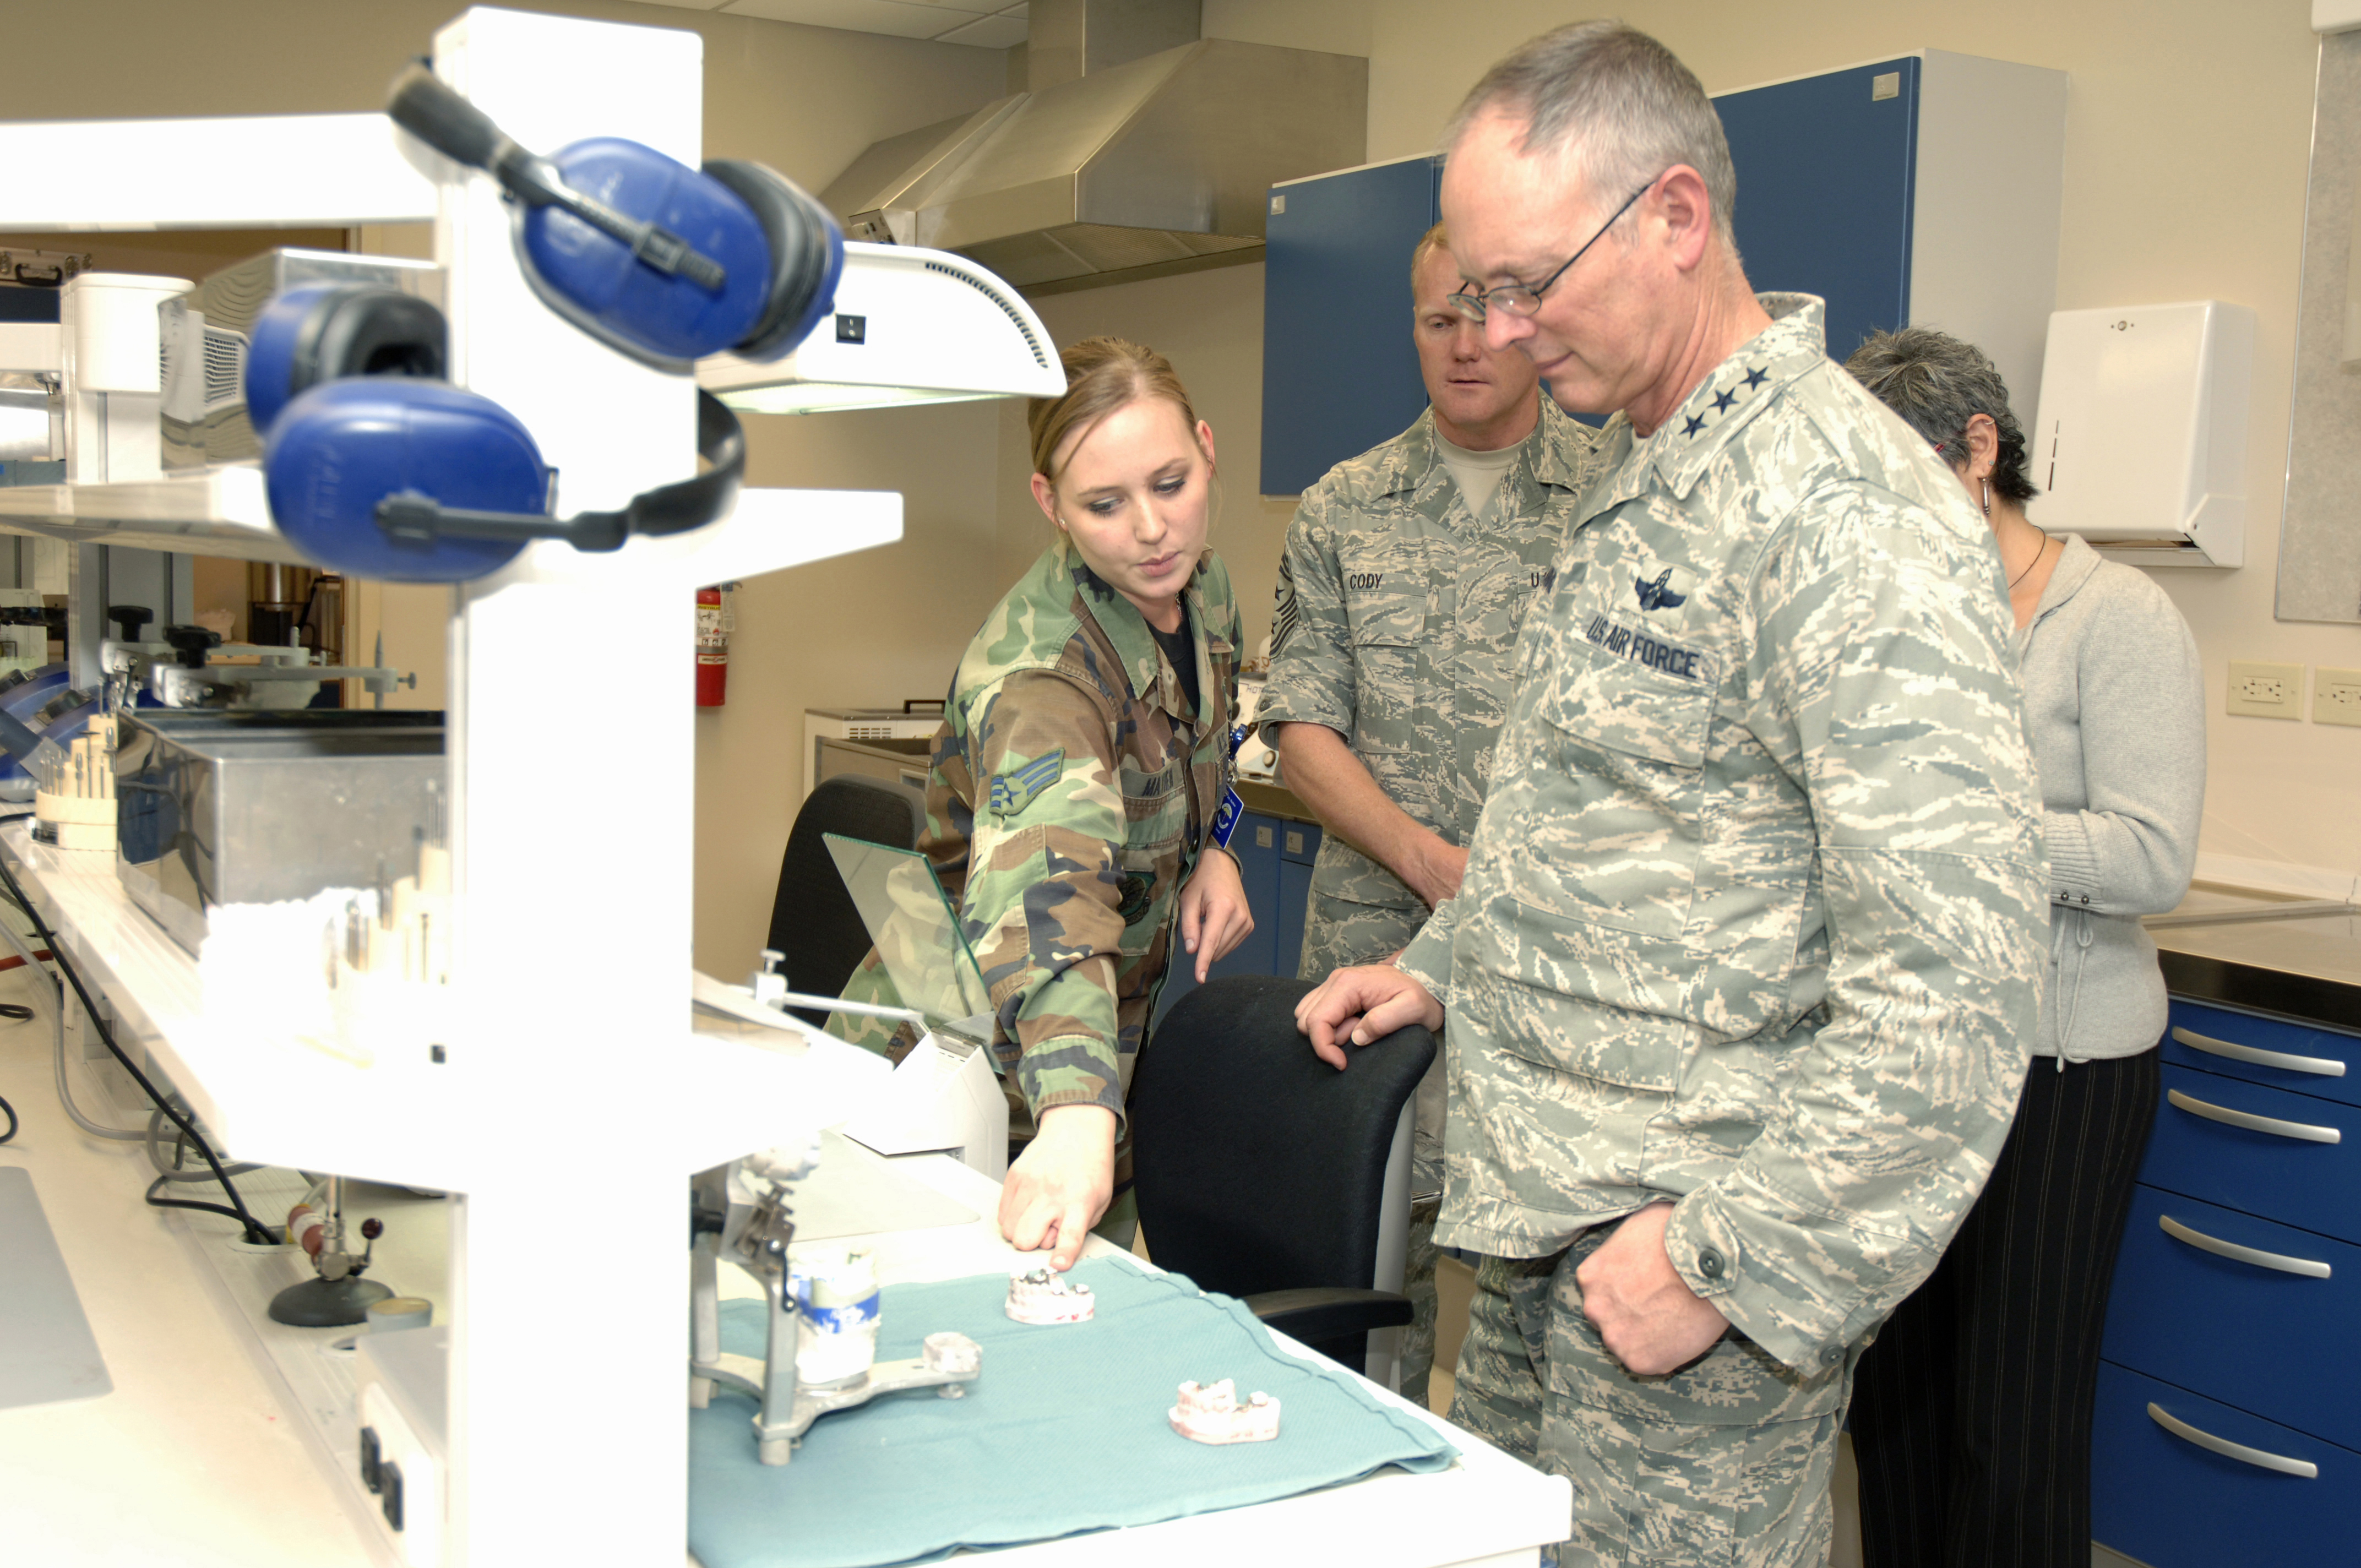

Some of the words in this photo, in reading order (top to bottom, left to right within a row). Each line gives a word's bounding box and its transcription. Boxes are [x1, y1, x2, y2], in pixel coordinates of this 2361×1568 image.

[1350, 573, 1383, 590] CODY
[1602, 624, 1631, 657] AIR
[1630, 634, 1700, 679] FORCE
